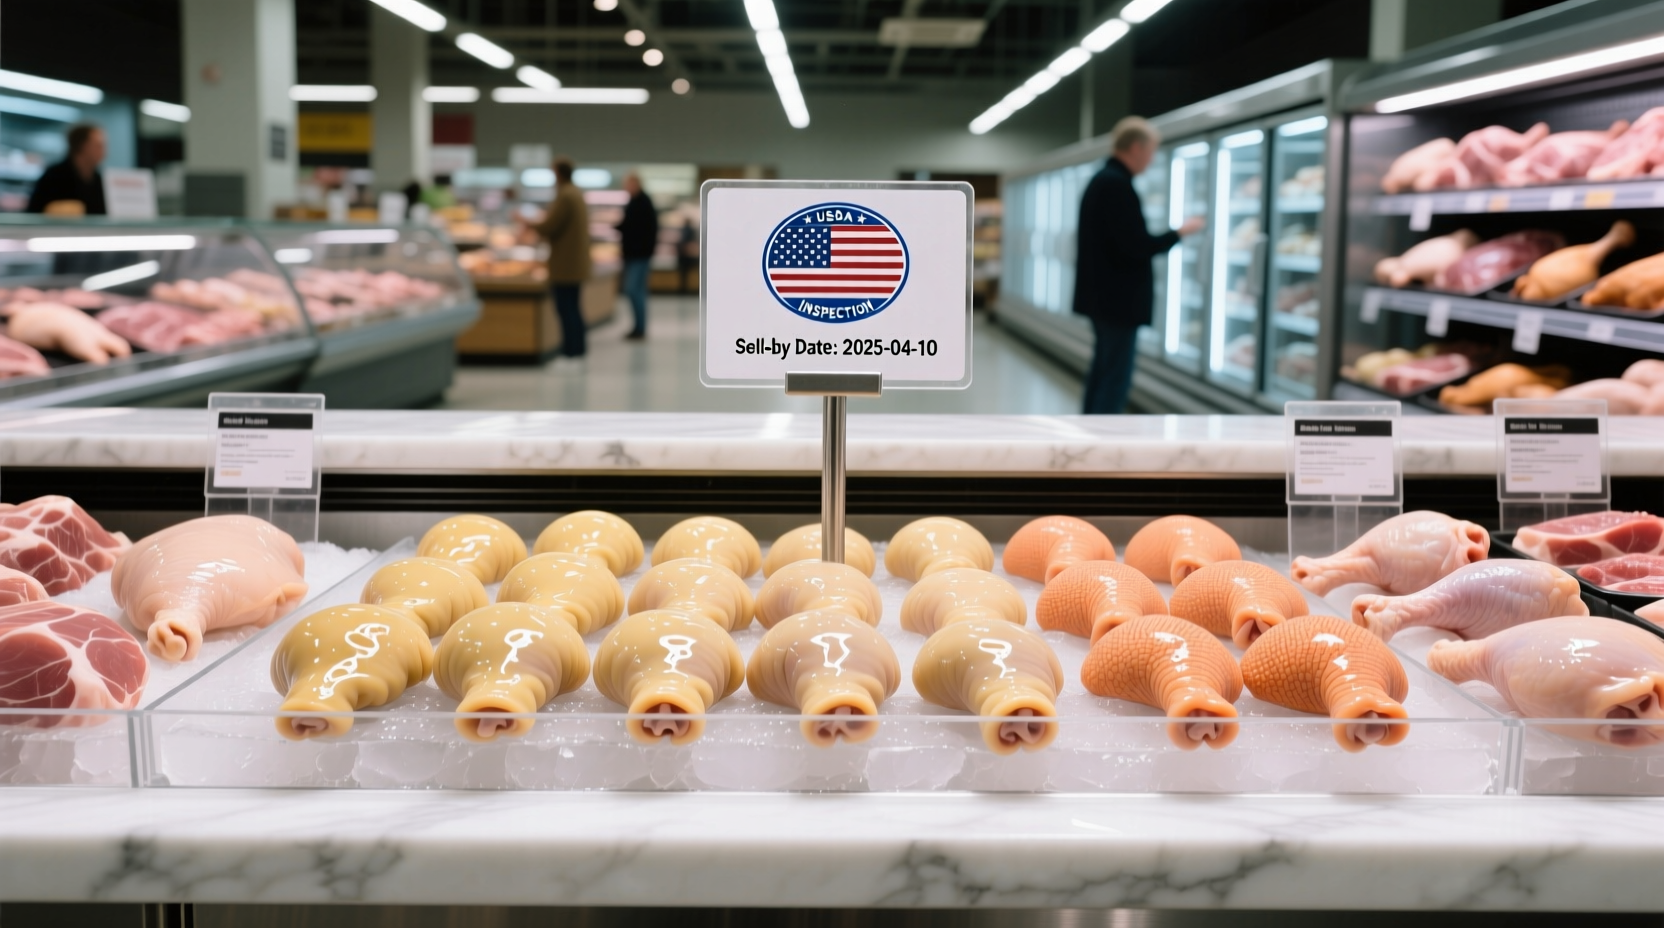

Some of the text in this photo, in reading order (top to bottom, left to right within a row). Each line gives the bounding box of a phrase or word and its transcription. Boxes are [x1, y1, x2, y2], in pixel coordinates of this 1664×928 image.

[816, 210, 853, 223] USDA
[798, 299, 875, 319] INSPECTION
[735, 337, 938, 360] Sell-by Date: 2025-04-10
